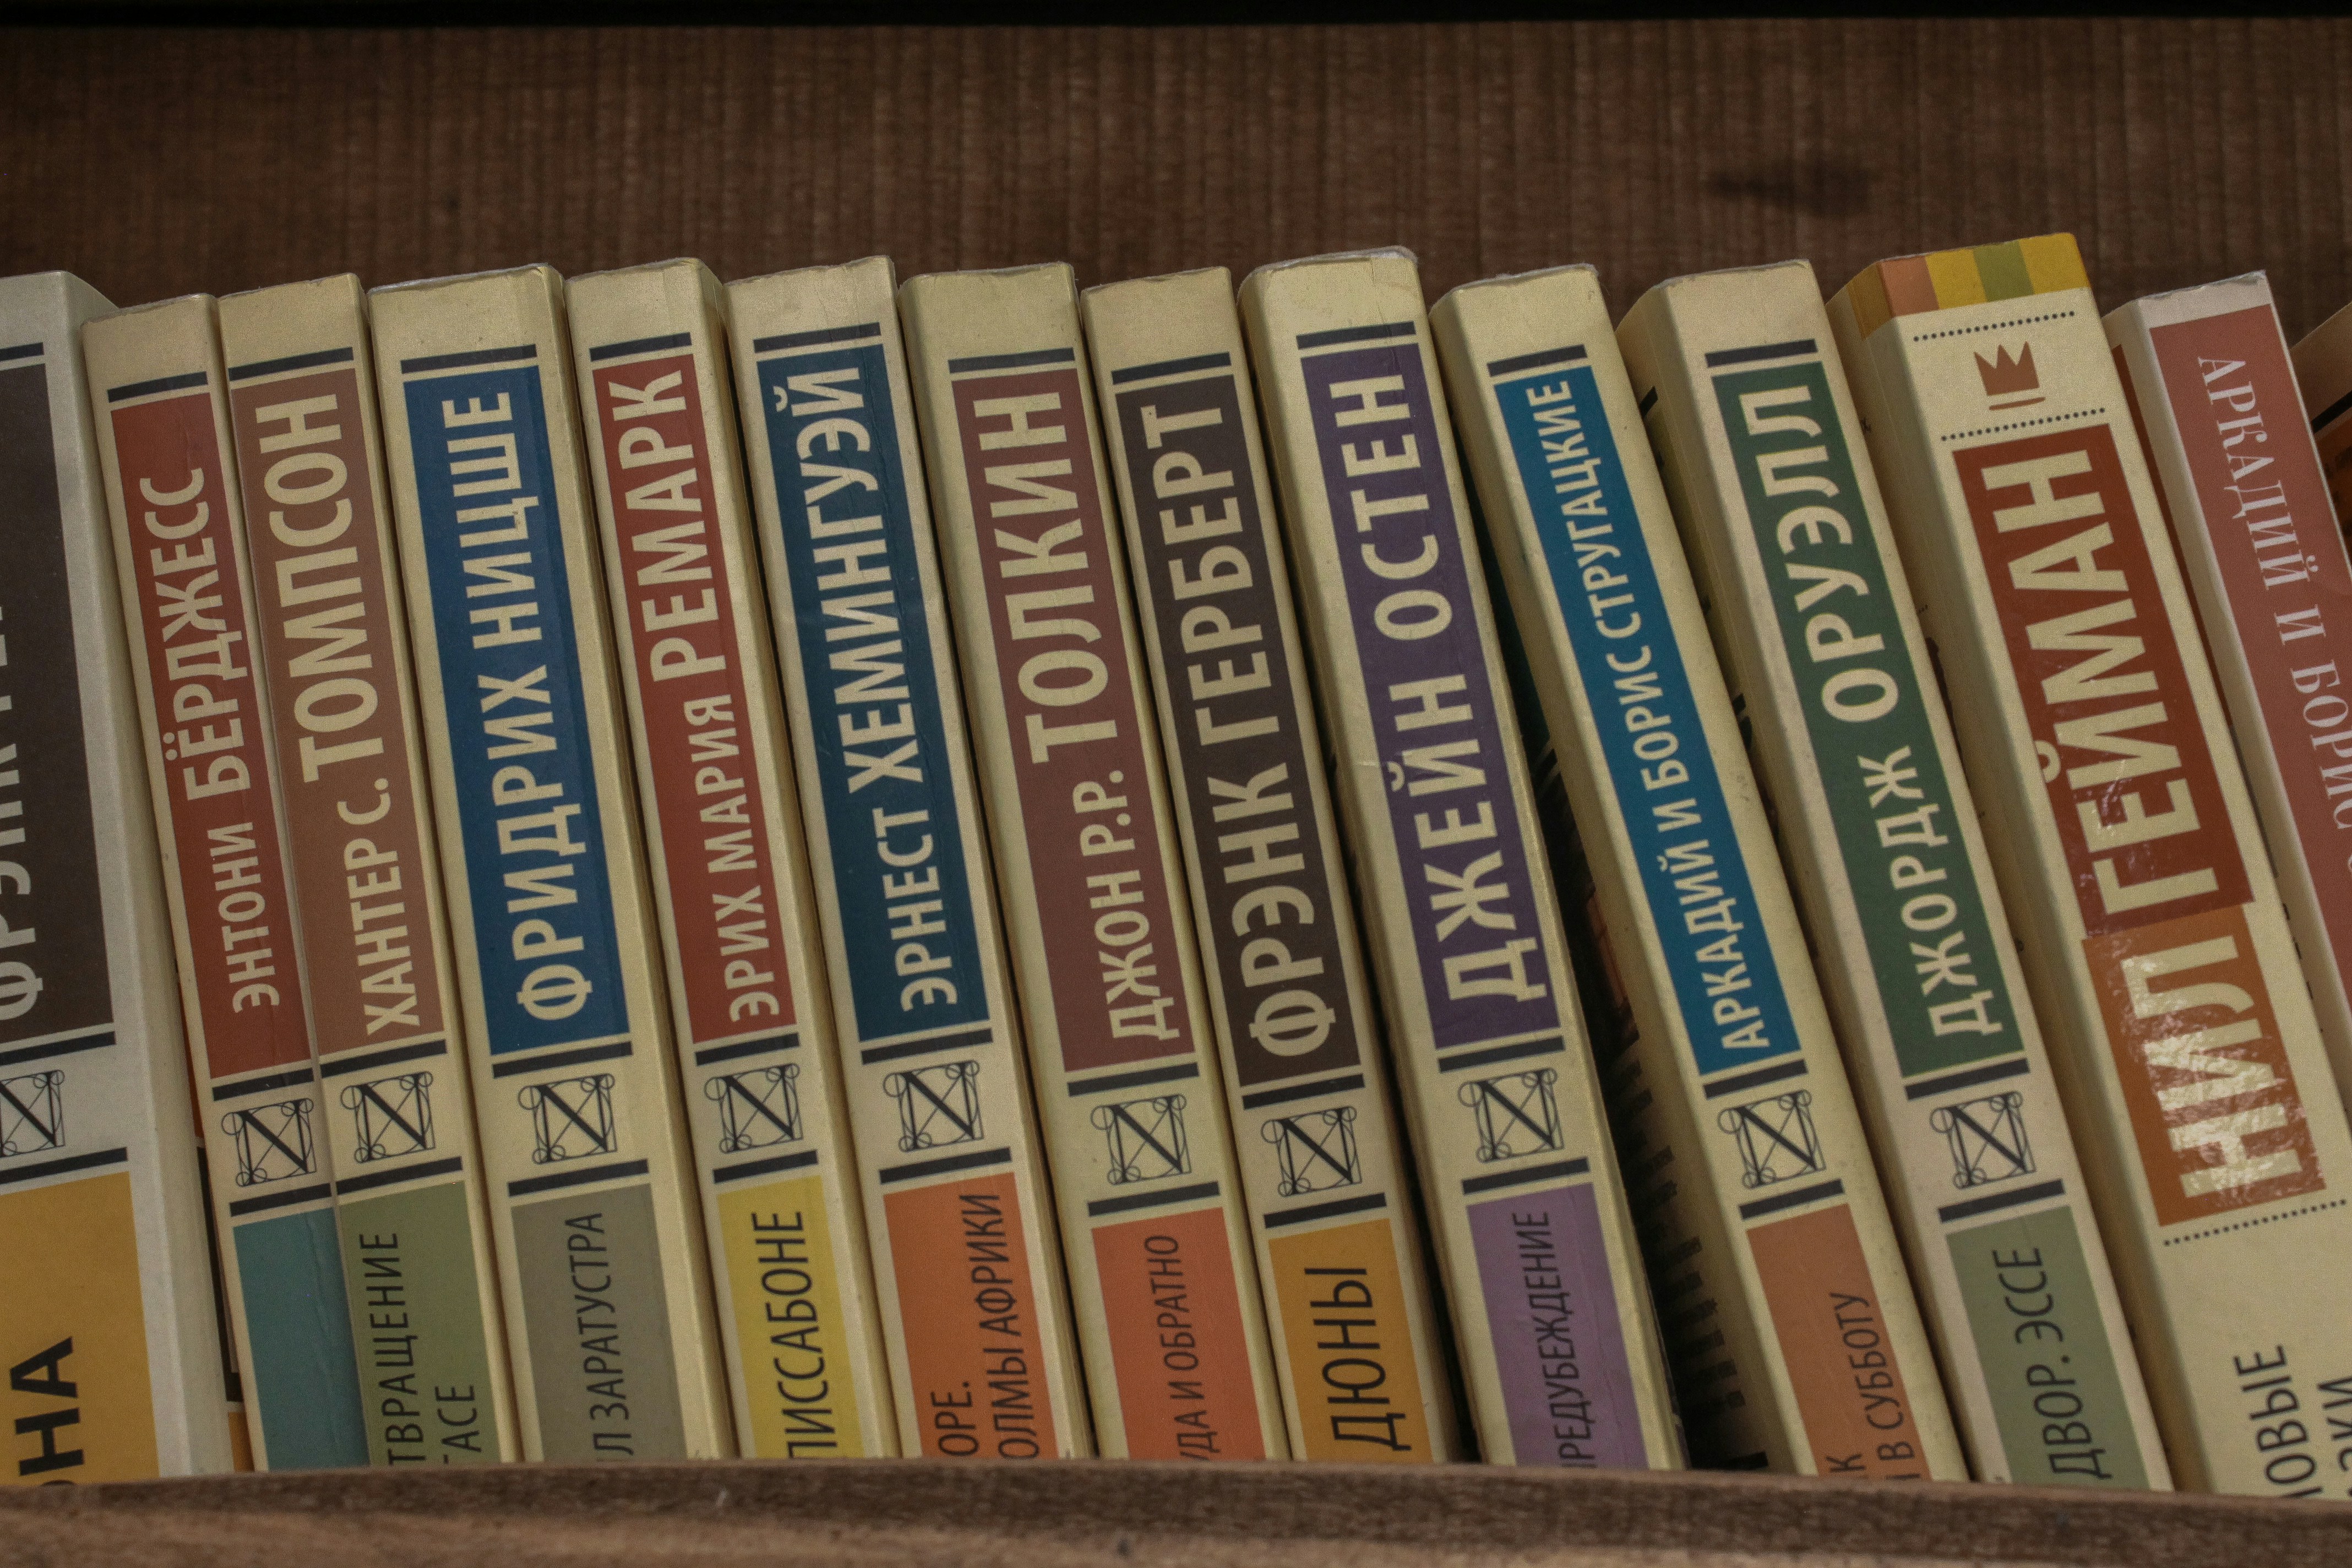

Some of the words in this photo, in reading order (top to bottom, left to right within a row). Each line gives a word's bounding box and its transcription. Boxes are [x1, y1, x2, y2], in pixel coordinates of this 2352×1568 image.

[255, 394, 384, 783] ТОМПСОН
[442, 392, 543, 649] НИЦШЕ
[608, 370, 726, 682] РЕМАРК
[773, 367, 923, 793] ХЕМИНГУЭЙ
[973, 392, 1118, 764] ТОЛКИН
[1141, 405, 1280, 745] ГЕРБЕРТ
[1329, 374, 1452, 641] ОСТЕН
[1526, 381, 1642, 639] СТРУГАЦКИЕ
[1739, 385, 1899, 722] ОРУЭЛЛ
[2197, 356, 2318, 590] АРКАДИЙ
[2274, 605, 2326, 645] И
[139, 468, 251, 801] БЁРДЖЕСС
[1606, 645, 1690, 791] БОРИС
[1981, 449, 2219, 915] ГЕЙМАН
[337, 778, 391, 825] С.
[477, 665, 593, 1020] ФРИДРИХ
[684, 694, 758, 873] МАРИЯ
[1072, 770, 1135, 856] Р.Р.
[1386, 674, 1547, 1002] ДЖЕЙН
[1653, 798, 1702, 832] И
[208, 823, 280, 1012] ЭНТОНИ
[344, 838, 420, 1035] ХАНТЕР
[712, 885, 780, 1021] ЭРИХ
[872, 808, 957, 1011] ЭРНЕСТ
[1086, 869, 1180, 1041] ДЖОН
[1207, 763, 1336, 1056] ФРЭНК
[1658, 840, 1770, 1049] АРКАДИЙ
[1858, 745, 2003, 1036] ДЖОРДЖ
[2121, 935, 2302, 1197] НИЛ
[565, 1212, 630, 1420] ЗАРАТУСТРА
[959, 1194, 1021, 1337] АФРИКИ
[1144, 1234, 1199, 1370] ОБРАТНО
[1304, 1267, 1411, 1451] ДЮНЫ
[1512, 1211, 1596, 1468] РЕДУБЕЖДЕНИЕ
[1830, 1292, 1904, 1430] СУББОТУ
[1992, 1246, 2065, 1343] ЭССЕ
[10, 1336, 84, 1485] НА
[434, 1384, 482, 1464] АСЕ
[1169, 1380, 1201, 1400] И
[2026, 1354, 2113, 1479] ДВОР.
